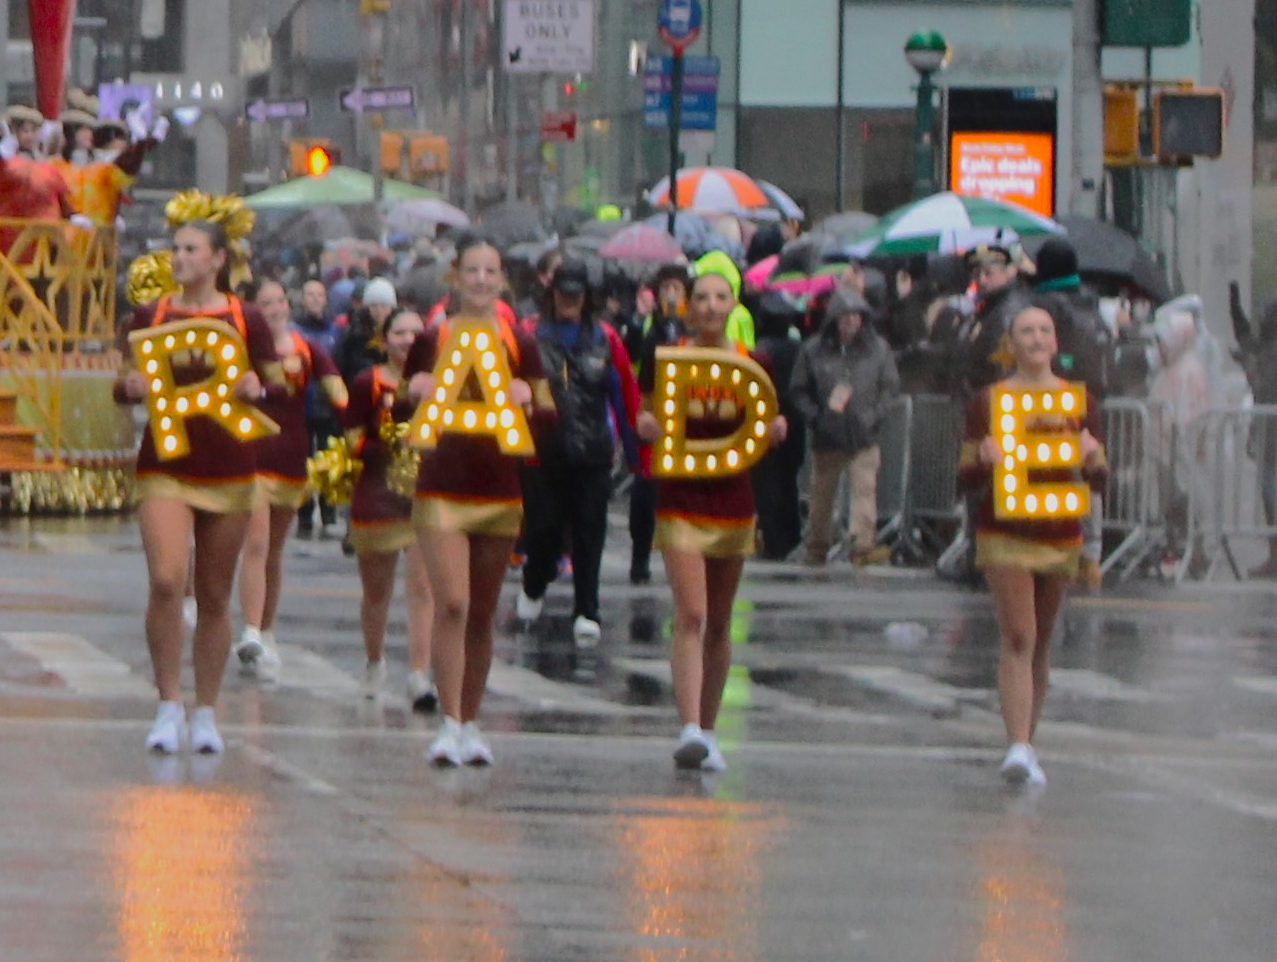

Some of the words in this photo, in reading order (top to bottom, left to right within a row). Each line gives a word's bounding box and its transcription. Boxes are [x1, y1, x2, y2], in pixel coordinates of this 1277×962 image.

[520, 3, 579, 19] BUSES
[525, 23, 571, 38] ONLY
[961, 156, 994, 177] Epic
[996, 156, 1043, 174] deals
[129, 318, 281, 462] R
[409, 314, 535, 456] A
[653, 346, 778, 478] D
[990, 381, 1091, 520] E
